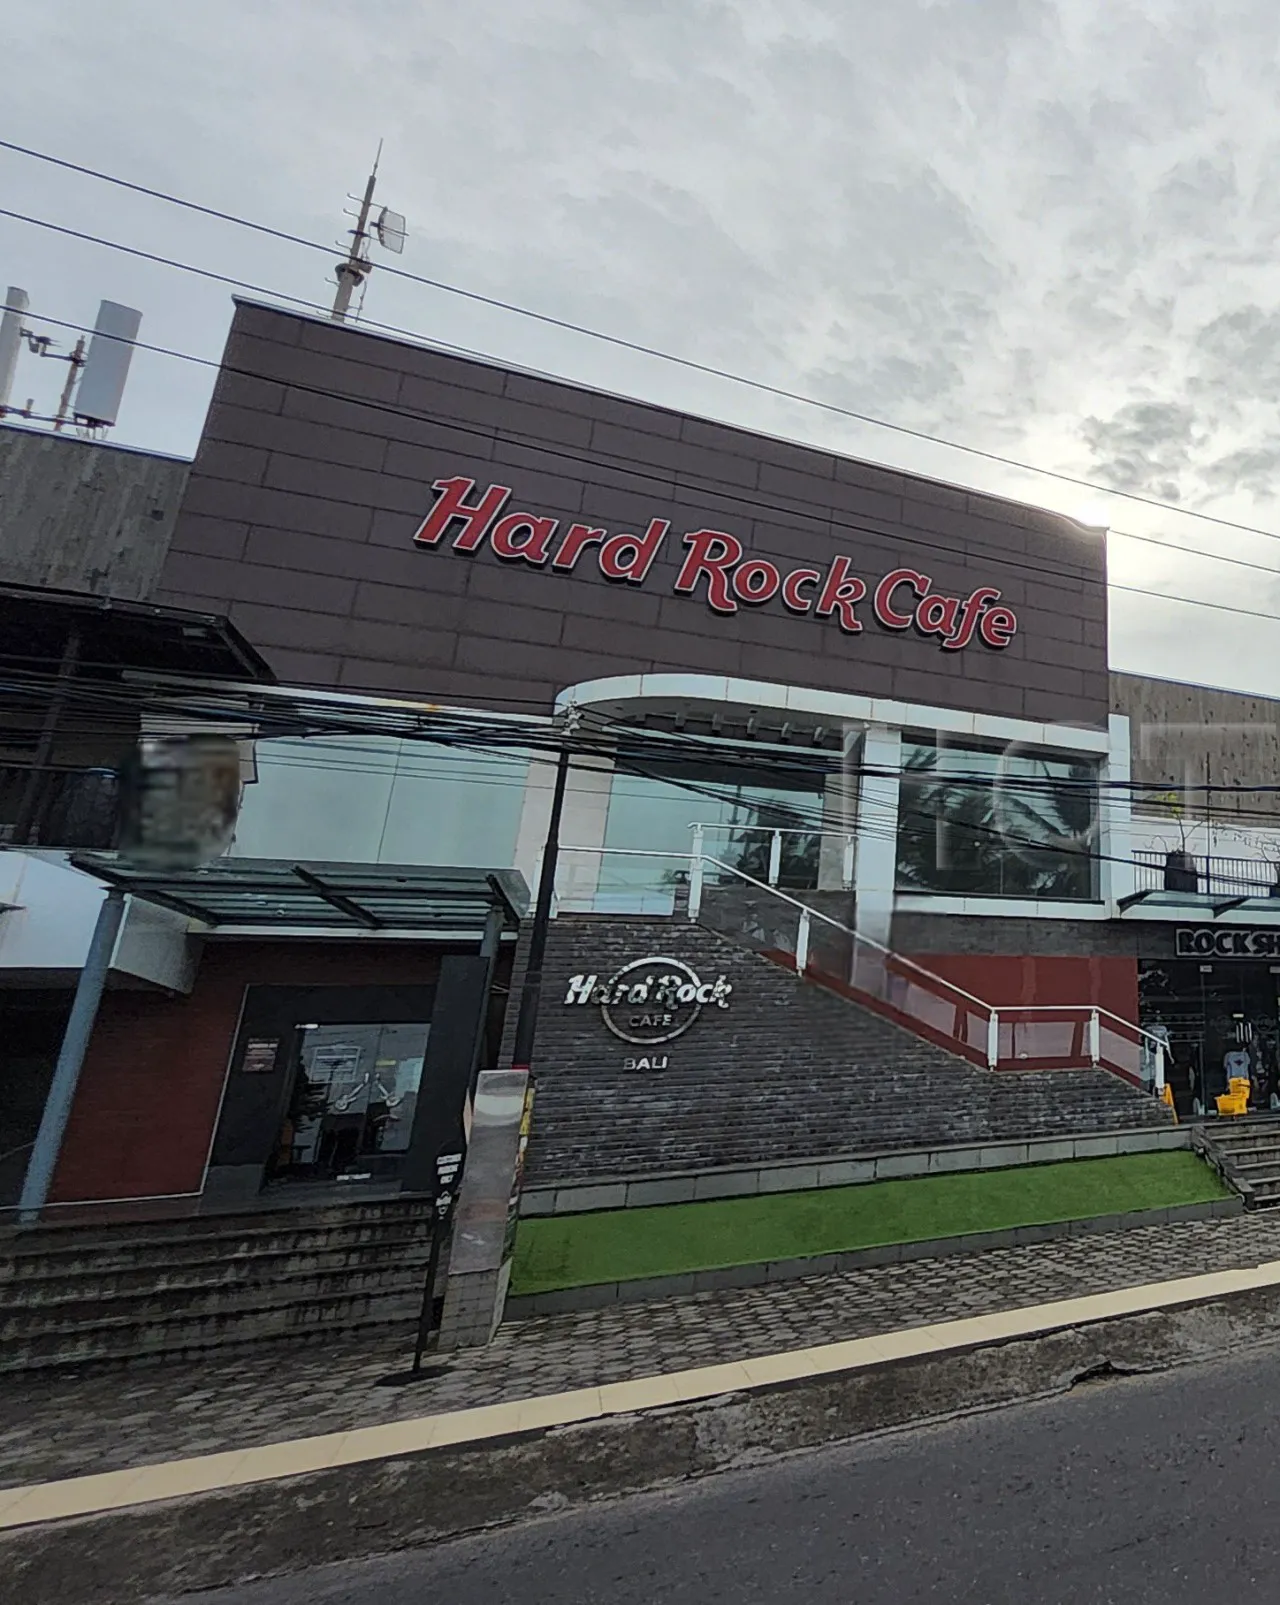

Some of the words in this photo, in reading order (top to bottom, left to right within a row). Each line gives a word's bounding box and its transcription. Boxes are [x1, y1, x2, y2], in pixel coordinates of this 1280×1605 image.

[413, 475, 670, 583] Hard
[673, 528, 866, 633] Rock
[873, 567, 1017, 652] Cafe
[1176, 929, 1251, 956] ROCK
[564, 974, 655, 1005] Hard
[655, 975, 732, 1009] Rock
[629, 1014, 673, 1027] CAFE
[623, 1056, 668, 1071] BALI
